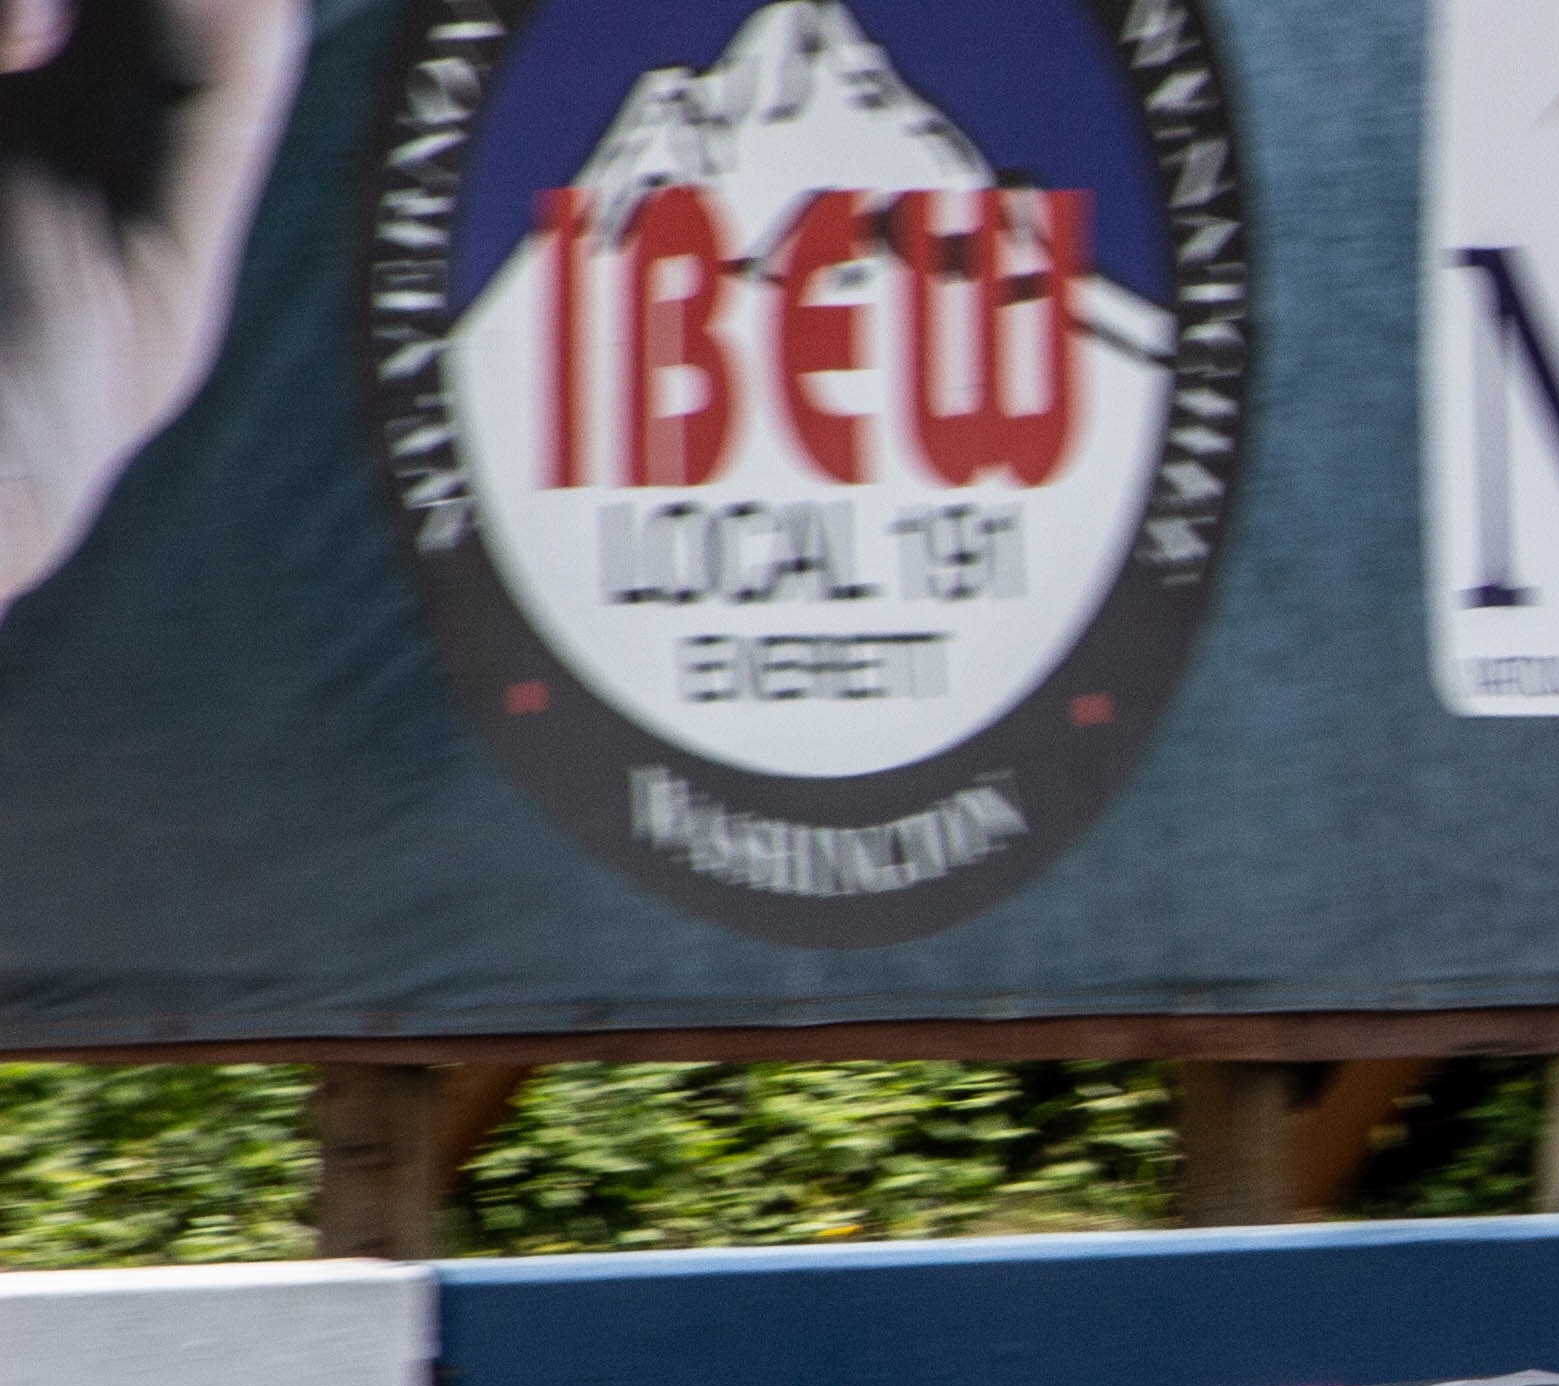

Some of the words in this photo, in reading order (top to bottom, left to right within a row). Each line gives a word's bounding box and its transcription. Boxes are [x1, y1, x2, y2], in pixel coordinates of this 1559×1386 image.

[534, 187, 1095, 490] IBEW
[597, 498, 880, 604] LOCAL
[888, 500, 1028, 602] 191
